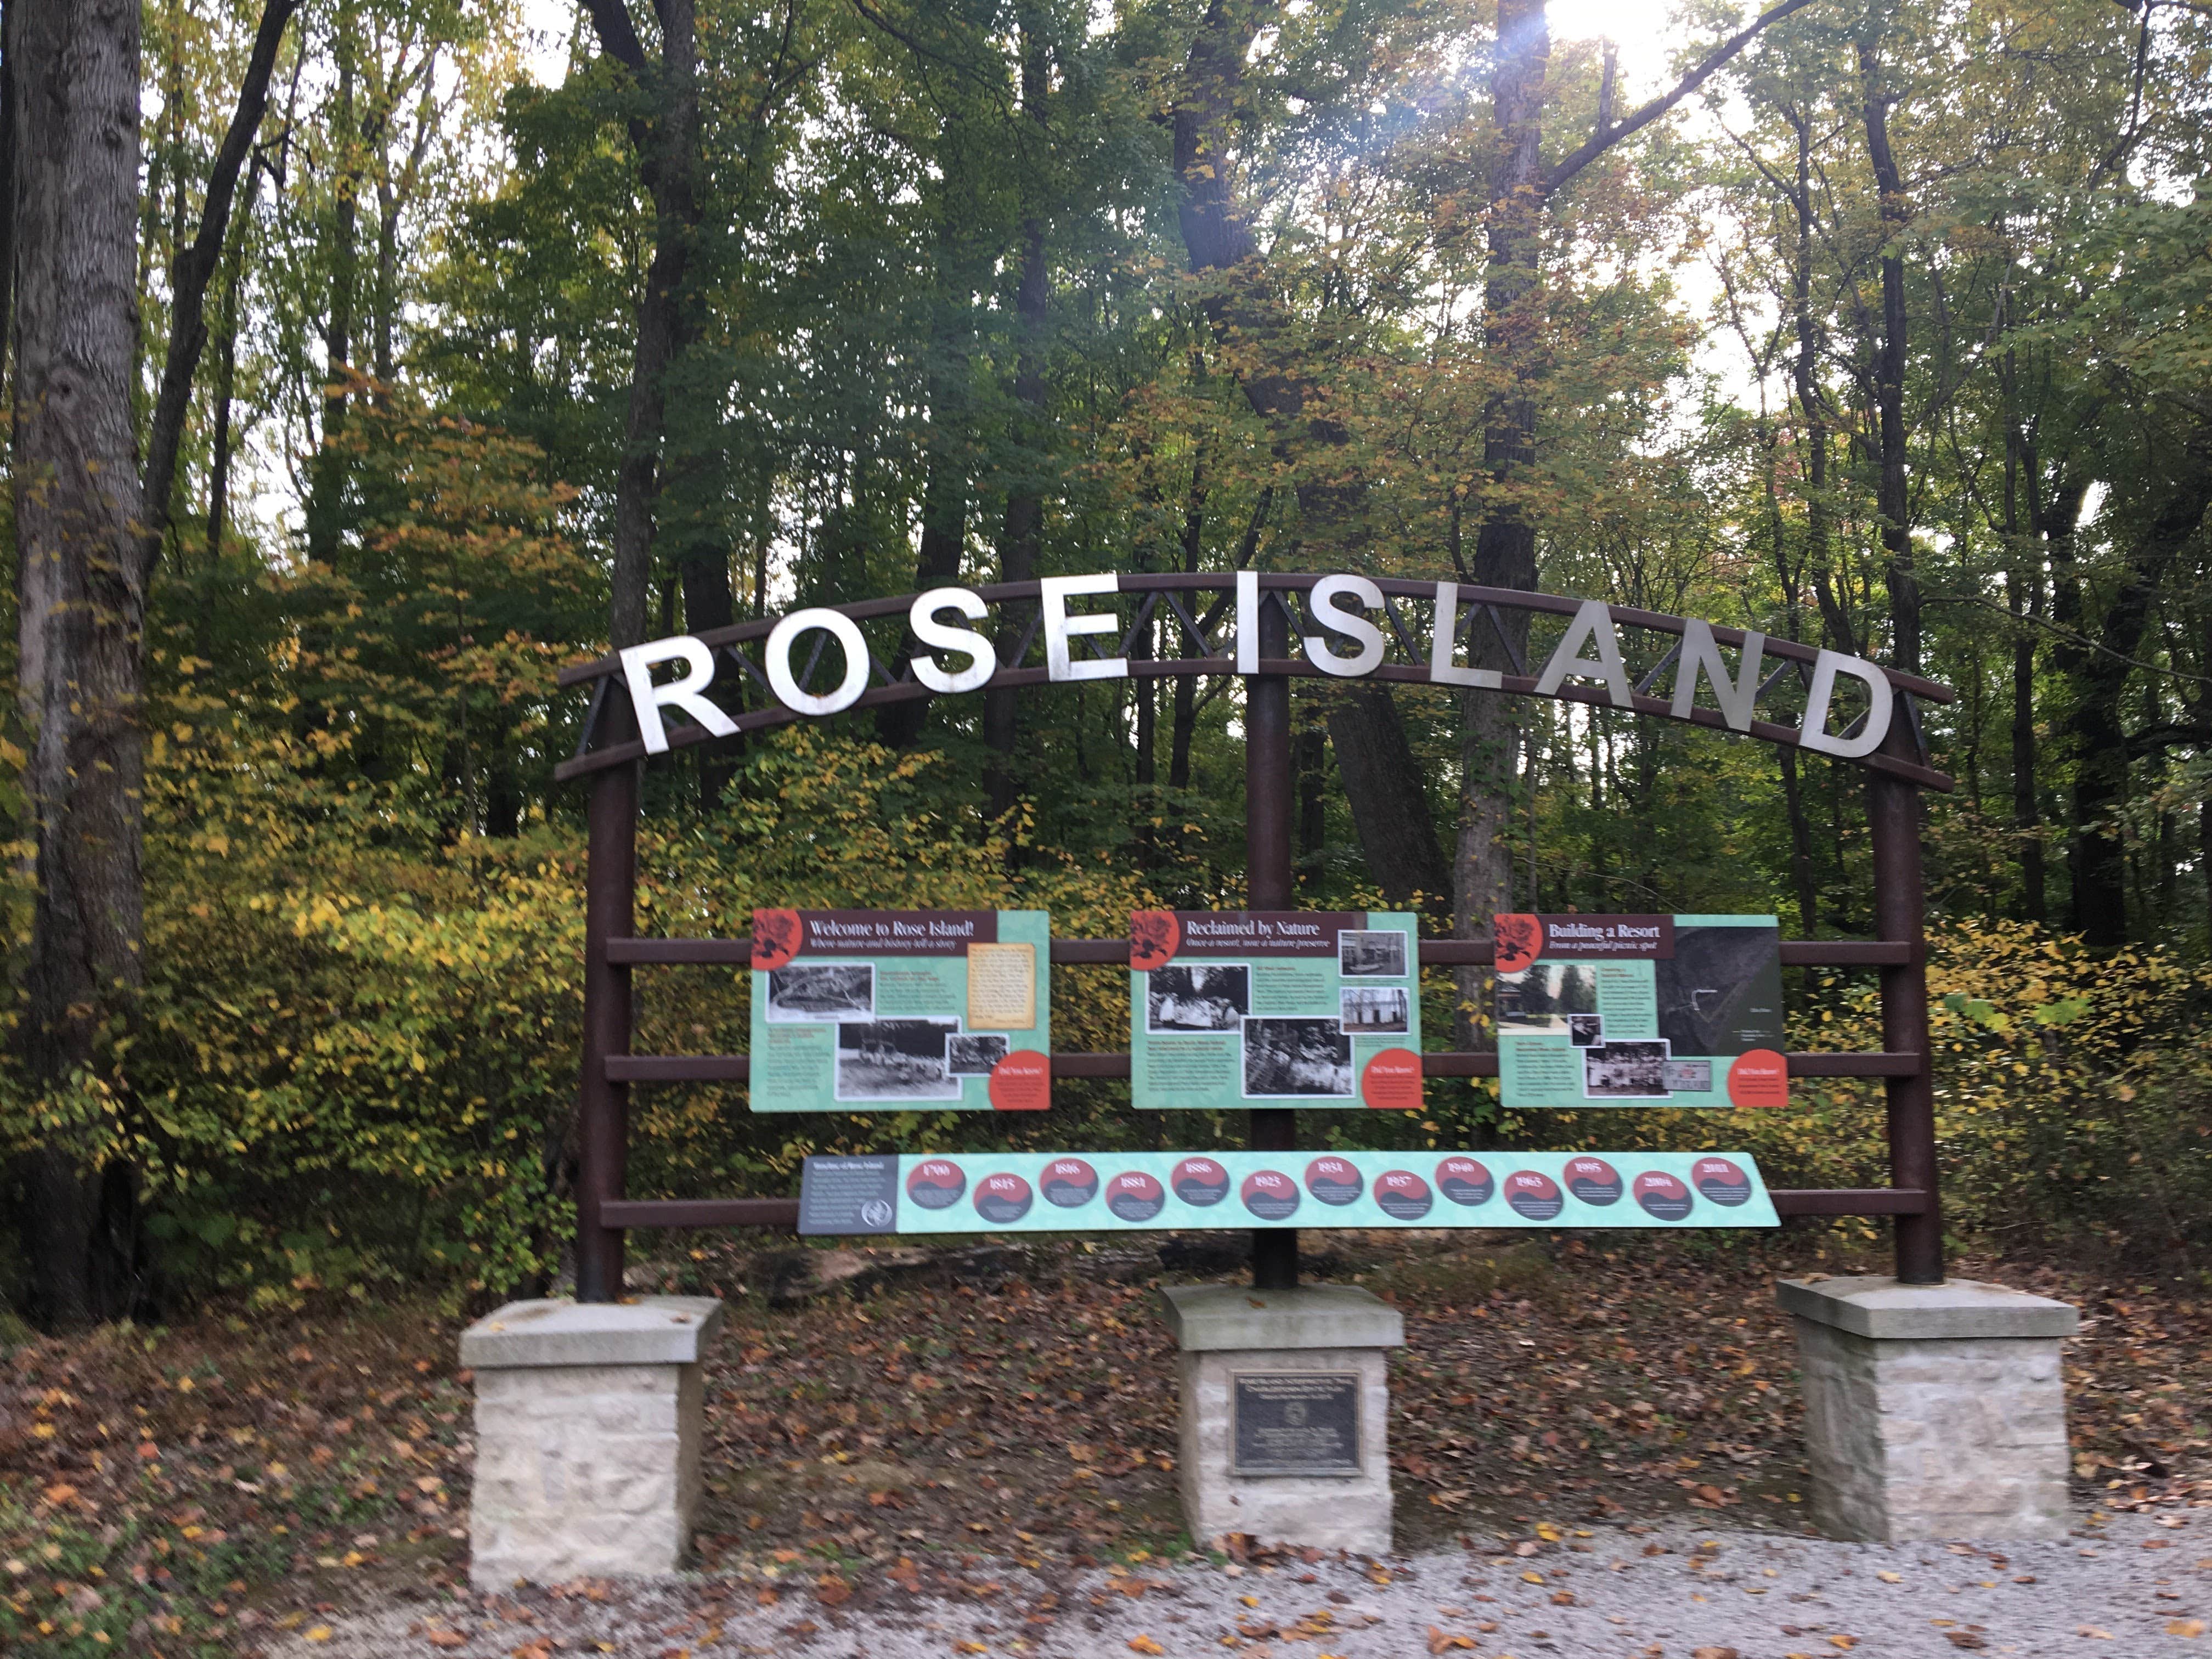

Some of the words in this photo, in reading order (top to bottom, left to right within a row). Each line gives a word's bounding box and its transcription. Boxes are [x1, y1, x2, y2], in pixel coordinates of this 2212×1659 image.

[619, 572, 1128, 754] ROSE
[1236, 571, 1894, 758] ISLAND
[810, 919, 873, 936] Welcome
[876, 922, 890, 936] to
[893, 921, 926, 936] Rose
[929, 920, 974, 937] Island!
[1187, 919, 1255, 935] Reclaimed
[1258, 920, 1274, 939] by
[1277, 921, 1321, 935] Nature
[1549, 923, 1605, 941] Building
[1606, 927, 1616, 937] a
[1618, 924, 1661, 938] Resort
[810, 938, 834, 948] Where
[836, 939, 865, 948] nature
[866, 938, 883, 948] and
[1186, 938, 1206, 947] Once
[1268, 939, 1296, 947] nature
[1295, 940, 1330, 950] preserve
[1577, 941, 1612, 951] peaceful
[1611, 941, 1638, 951] picnic
[1638, 942, 1657, 951] spot
